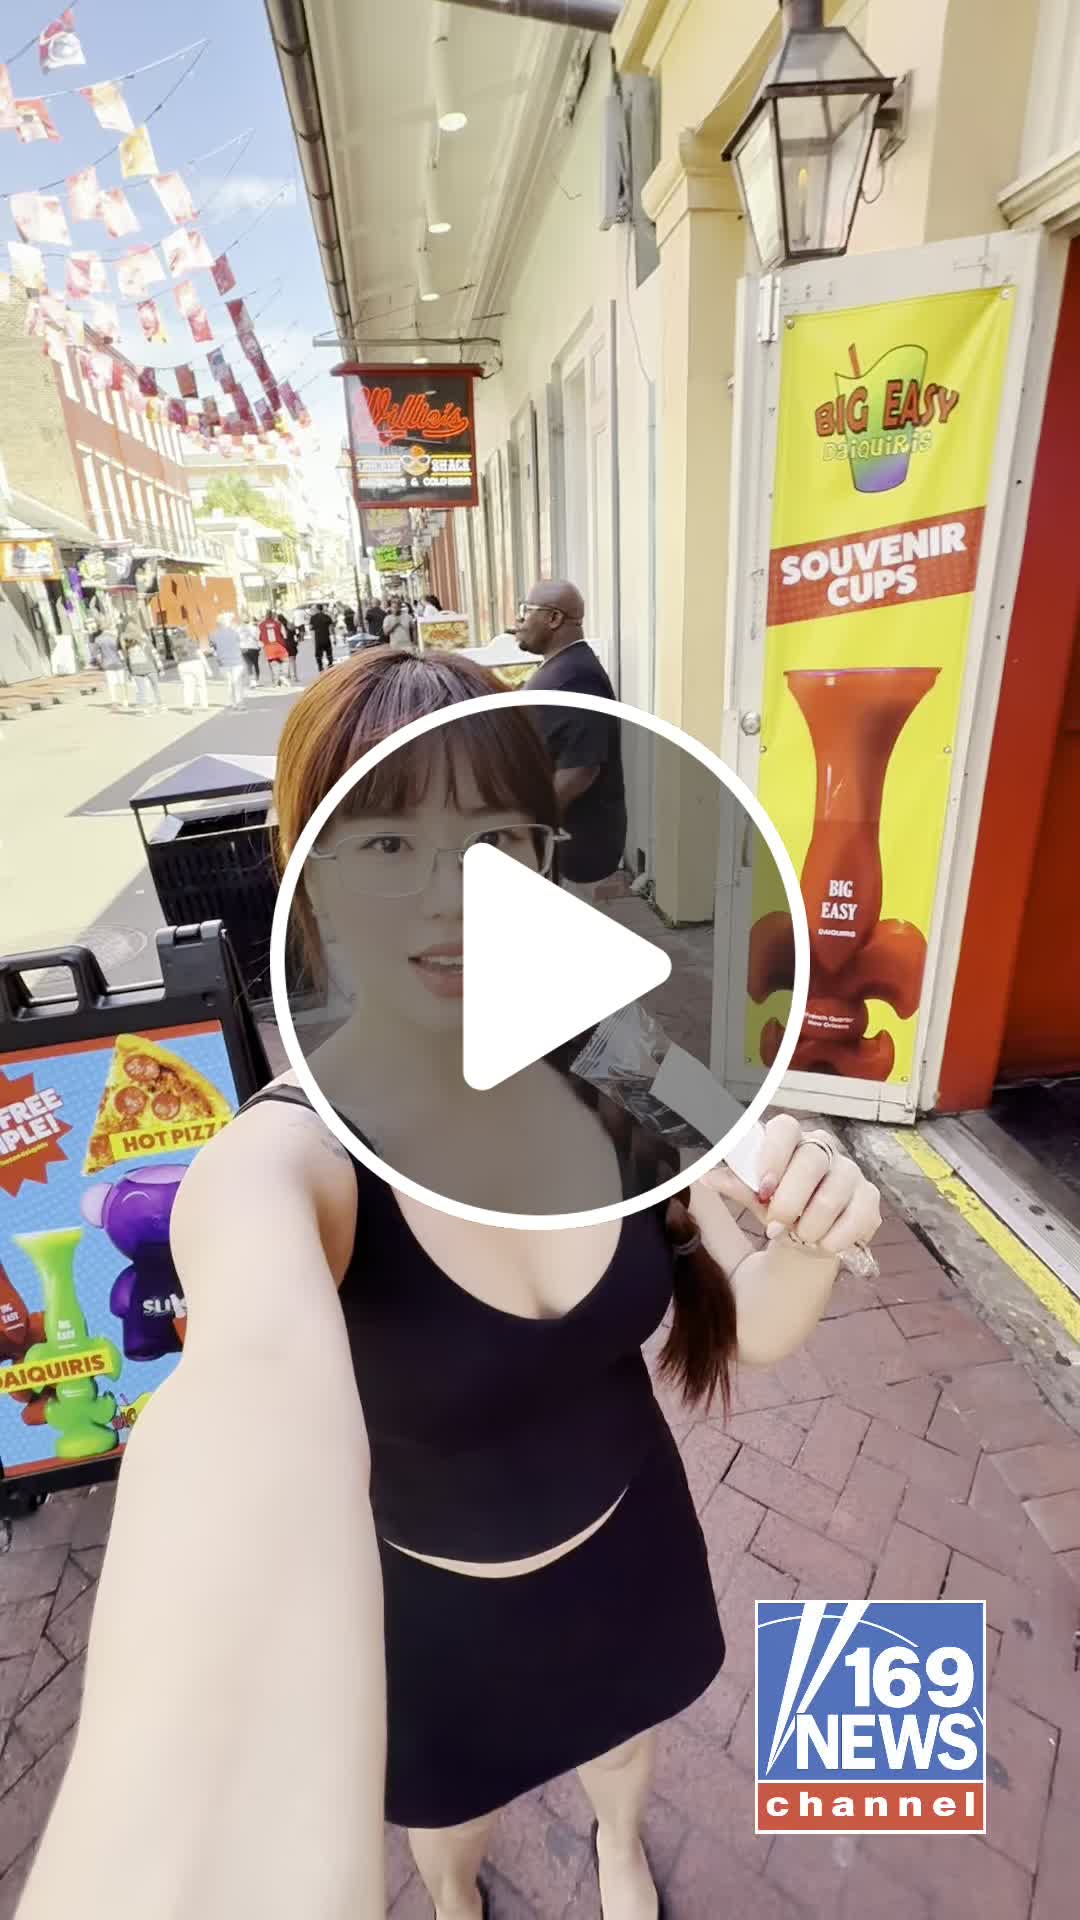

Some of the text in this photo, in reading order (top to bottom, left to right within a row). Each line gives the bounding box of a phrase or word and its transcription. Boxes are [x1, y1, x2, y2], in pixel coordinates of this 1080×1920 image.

[361, 385, 469, 438] Willie's
[814, 379, 959, 436] BIG EASY
[780, 522, 967, 585] SOUVENIR
[827, 564, 917, 607] CUPS
[829, 879, 853, 897] BIG
[821, 902, 858, 920] EASY
[122, 1121, 228, 1152] HOT PIZZ
[0, 1354, 105, 1388] AIQUIRIS
